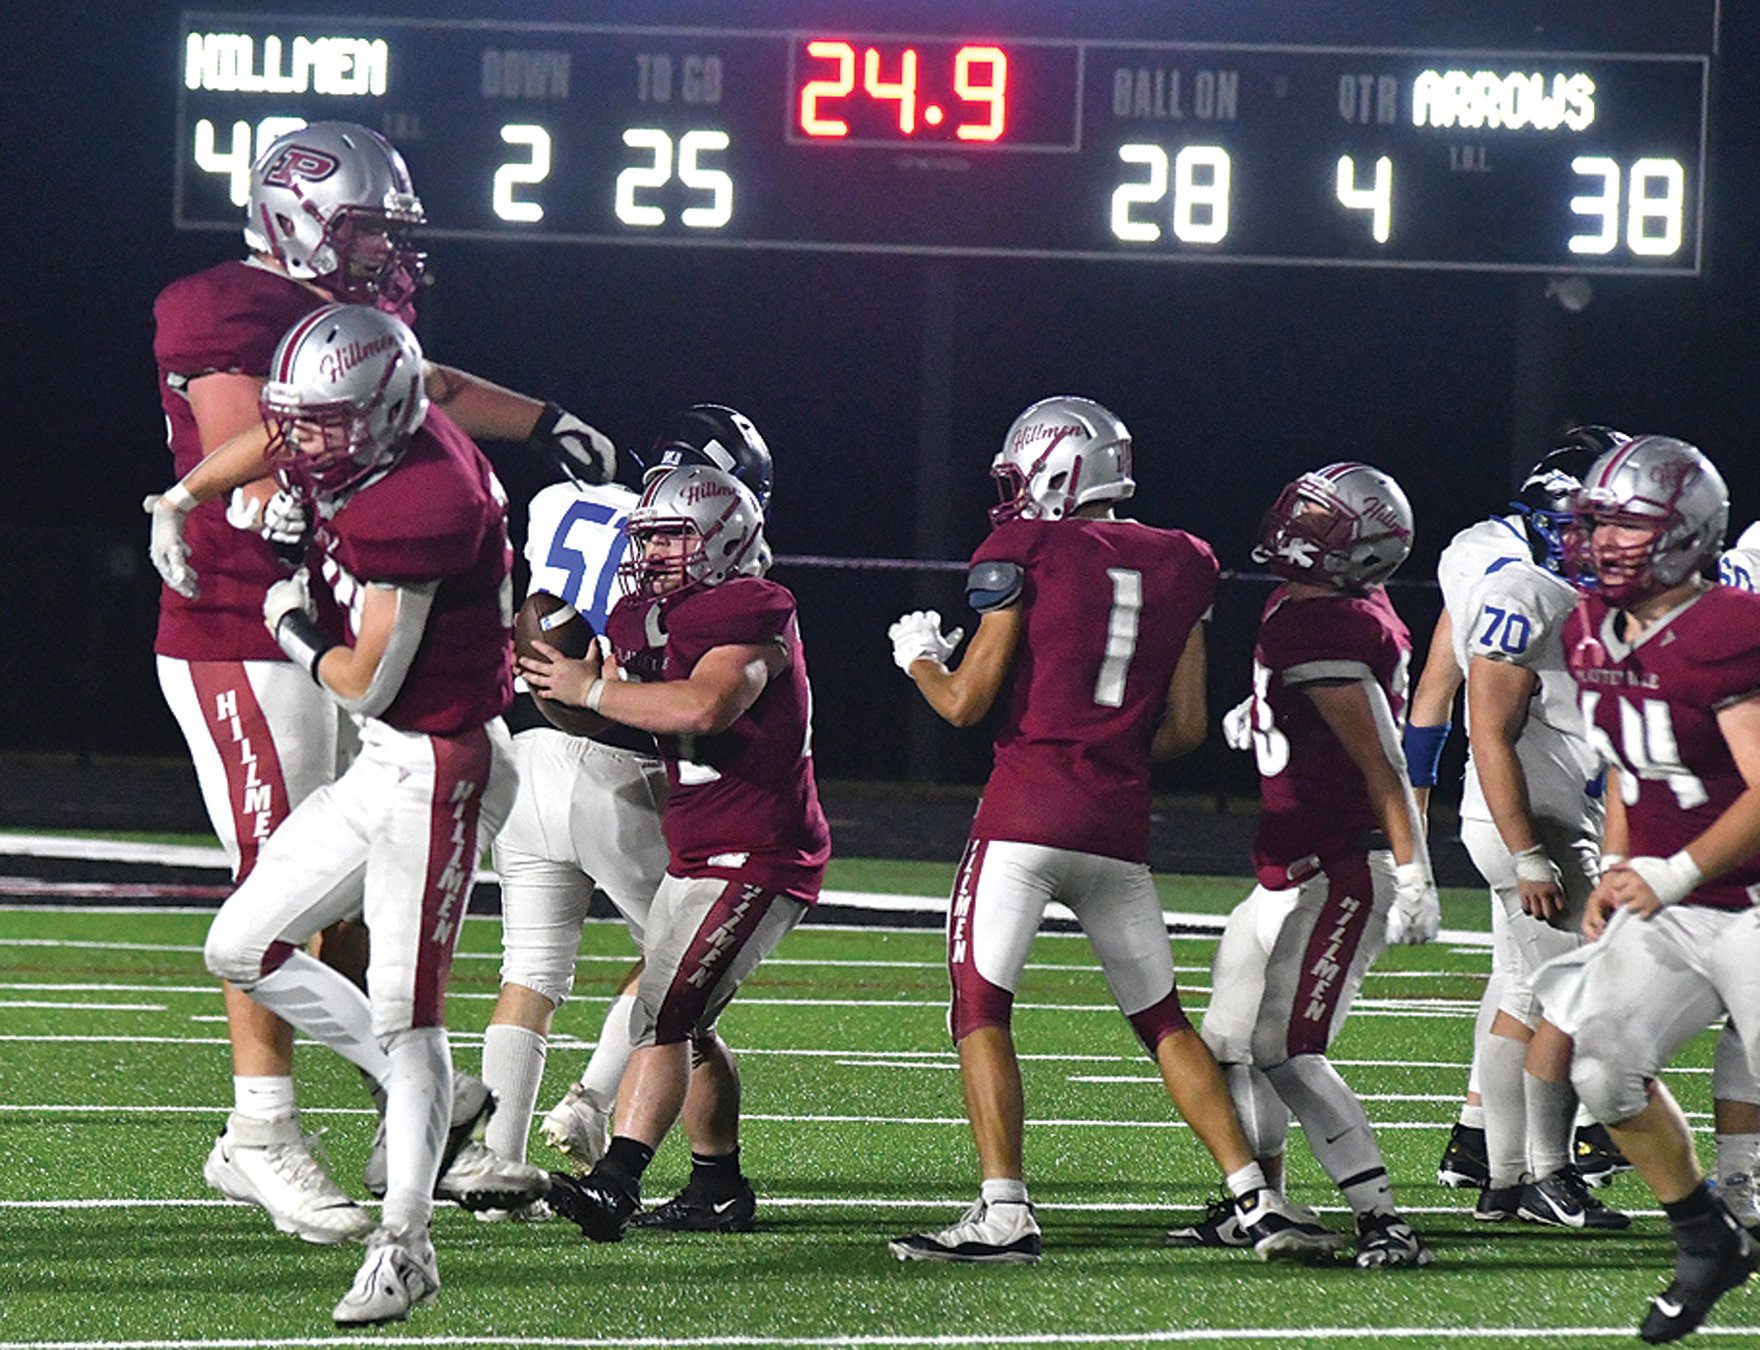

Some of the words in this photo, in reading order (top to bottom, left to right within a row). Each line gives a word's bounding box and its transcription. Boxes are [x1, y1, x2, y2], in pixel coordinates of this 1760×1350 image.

[185, 32, 388, 95] HILLMEN
[801, 41, 1007, 141] 24.9
[1113, 67, 1183, 119] BALL
[1194, 69, 1238, 120] ON
[1338, 74, 1397, 124] QTR
[1412, 70, 1596, 132] ARROWS
[262, 144, 340, 189] P
[493, 124, 551, 222] 2
[615, 128, 733, 227] 25
[1111, 144, 1230, 244] 28
[1336, 155, 1392, 244] 4
[1568, 156, 1684, 255] 38
[1012, 424, 1083, 454] Hillmen
[1095, 569, 1143, 708] 1
[1480, 605, 1531, 654] 70
[216, 690, 272, 843] HILLME
[431, 780, 476, 945] HILLMEN
[1303, 896, 1361, 1022] HILLMEN
